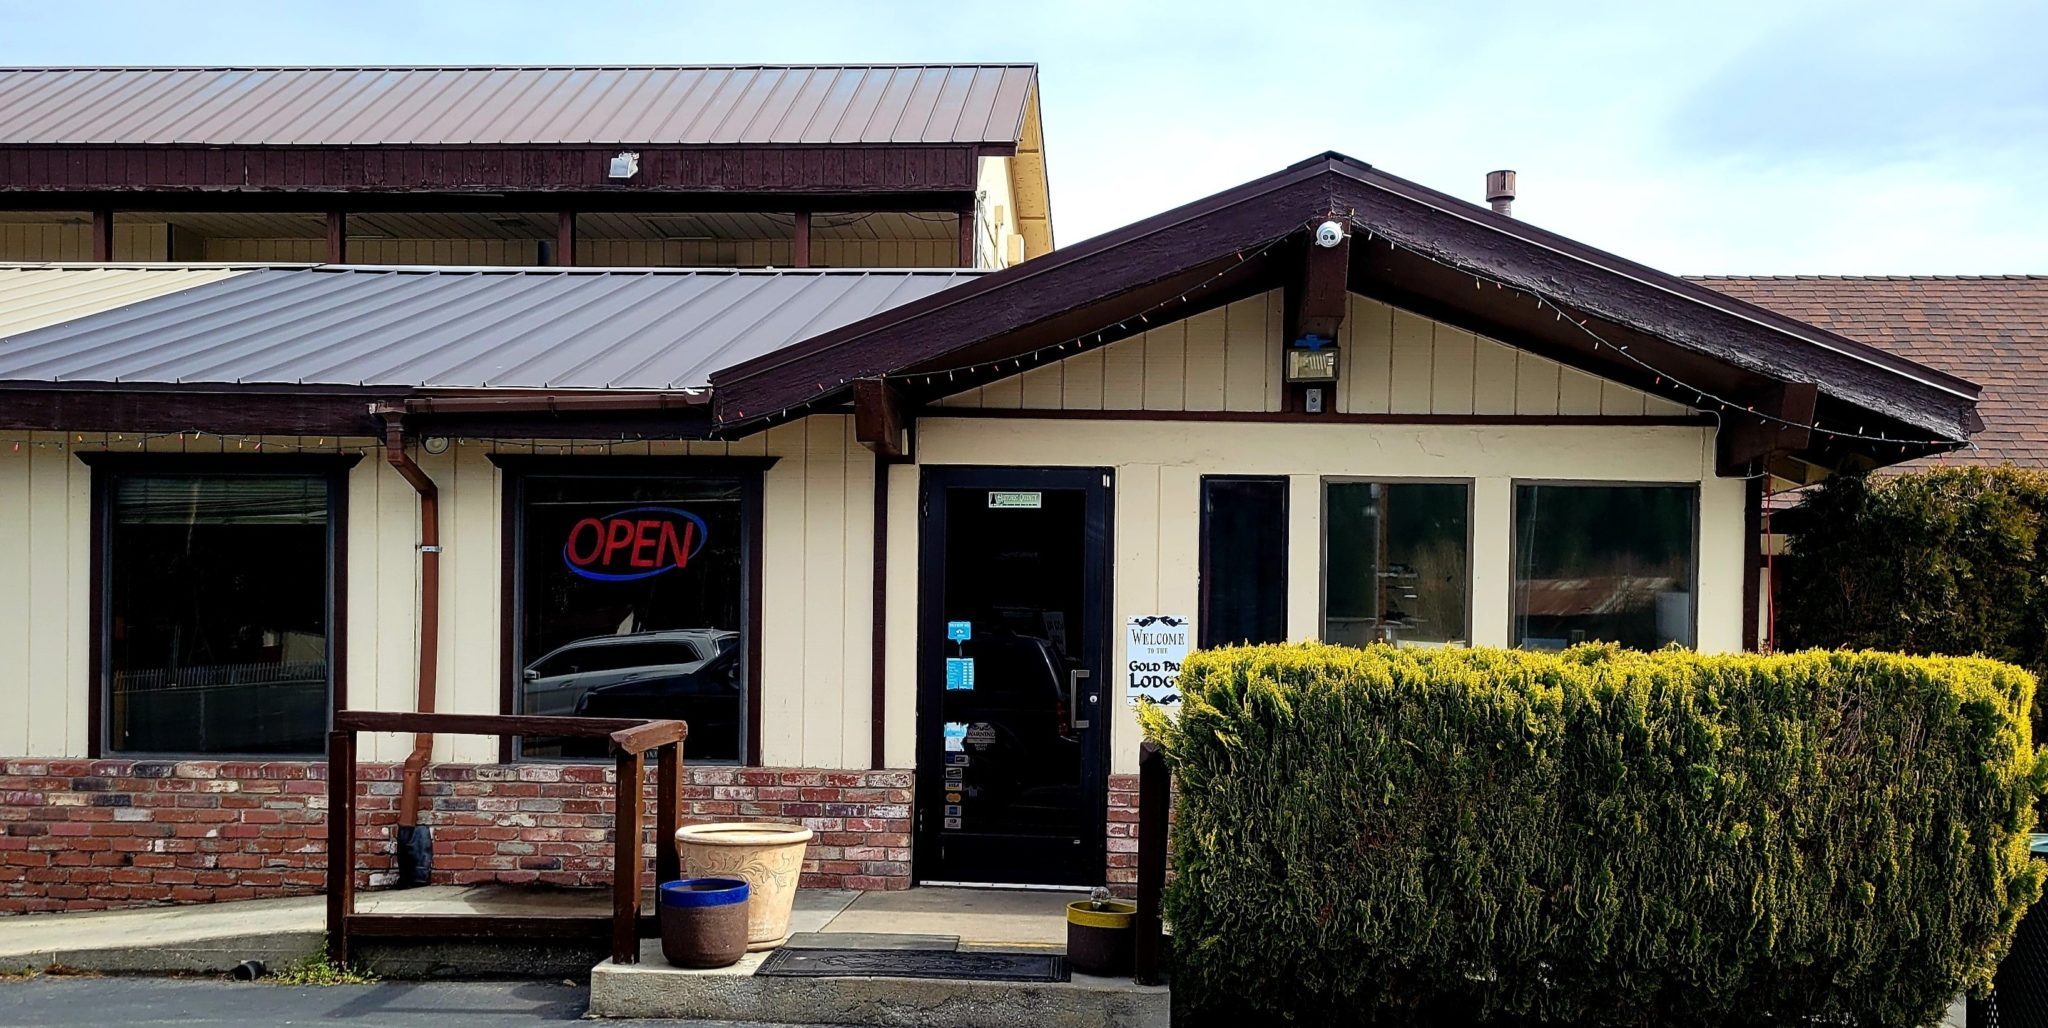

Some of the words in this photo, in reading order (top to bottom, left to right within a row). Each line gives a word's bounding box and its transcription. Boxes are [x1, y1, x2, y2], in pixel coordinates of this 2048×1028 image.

[567, 517, 695, 568] OPEN
[1132, 629, 1185, 646] WELCOME
[1147, 647, 1155, 655] TO
[1157, 647, 1169, 655] THE
[1129, 660, 1161, 672] GOLD
